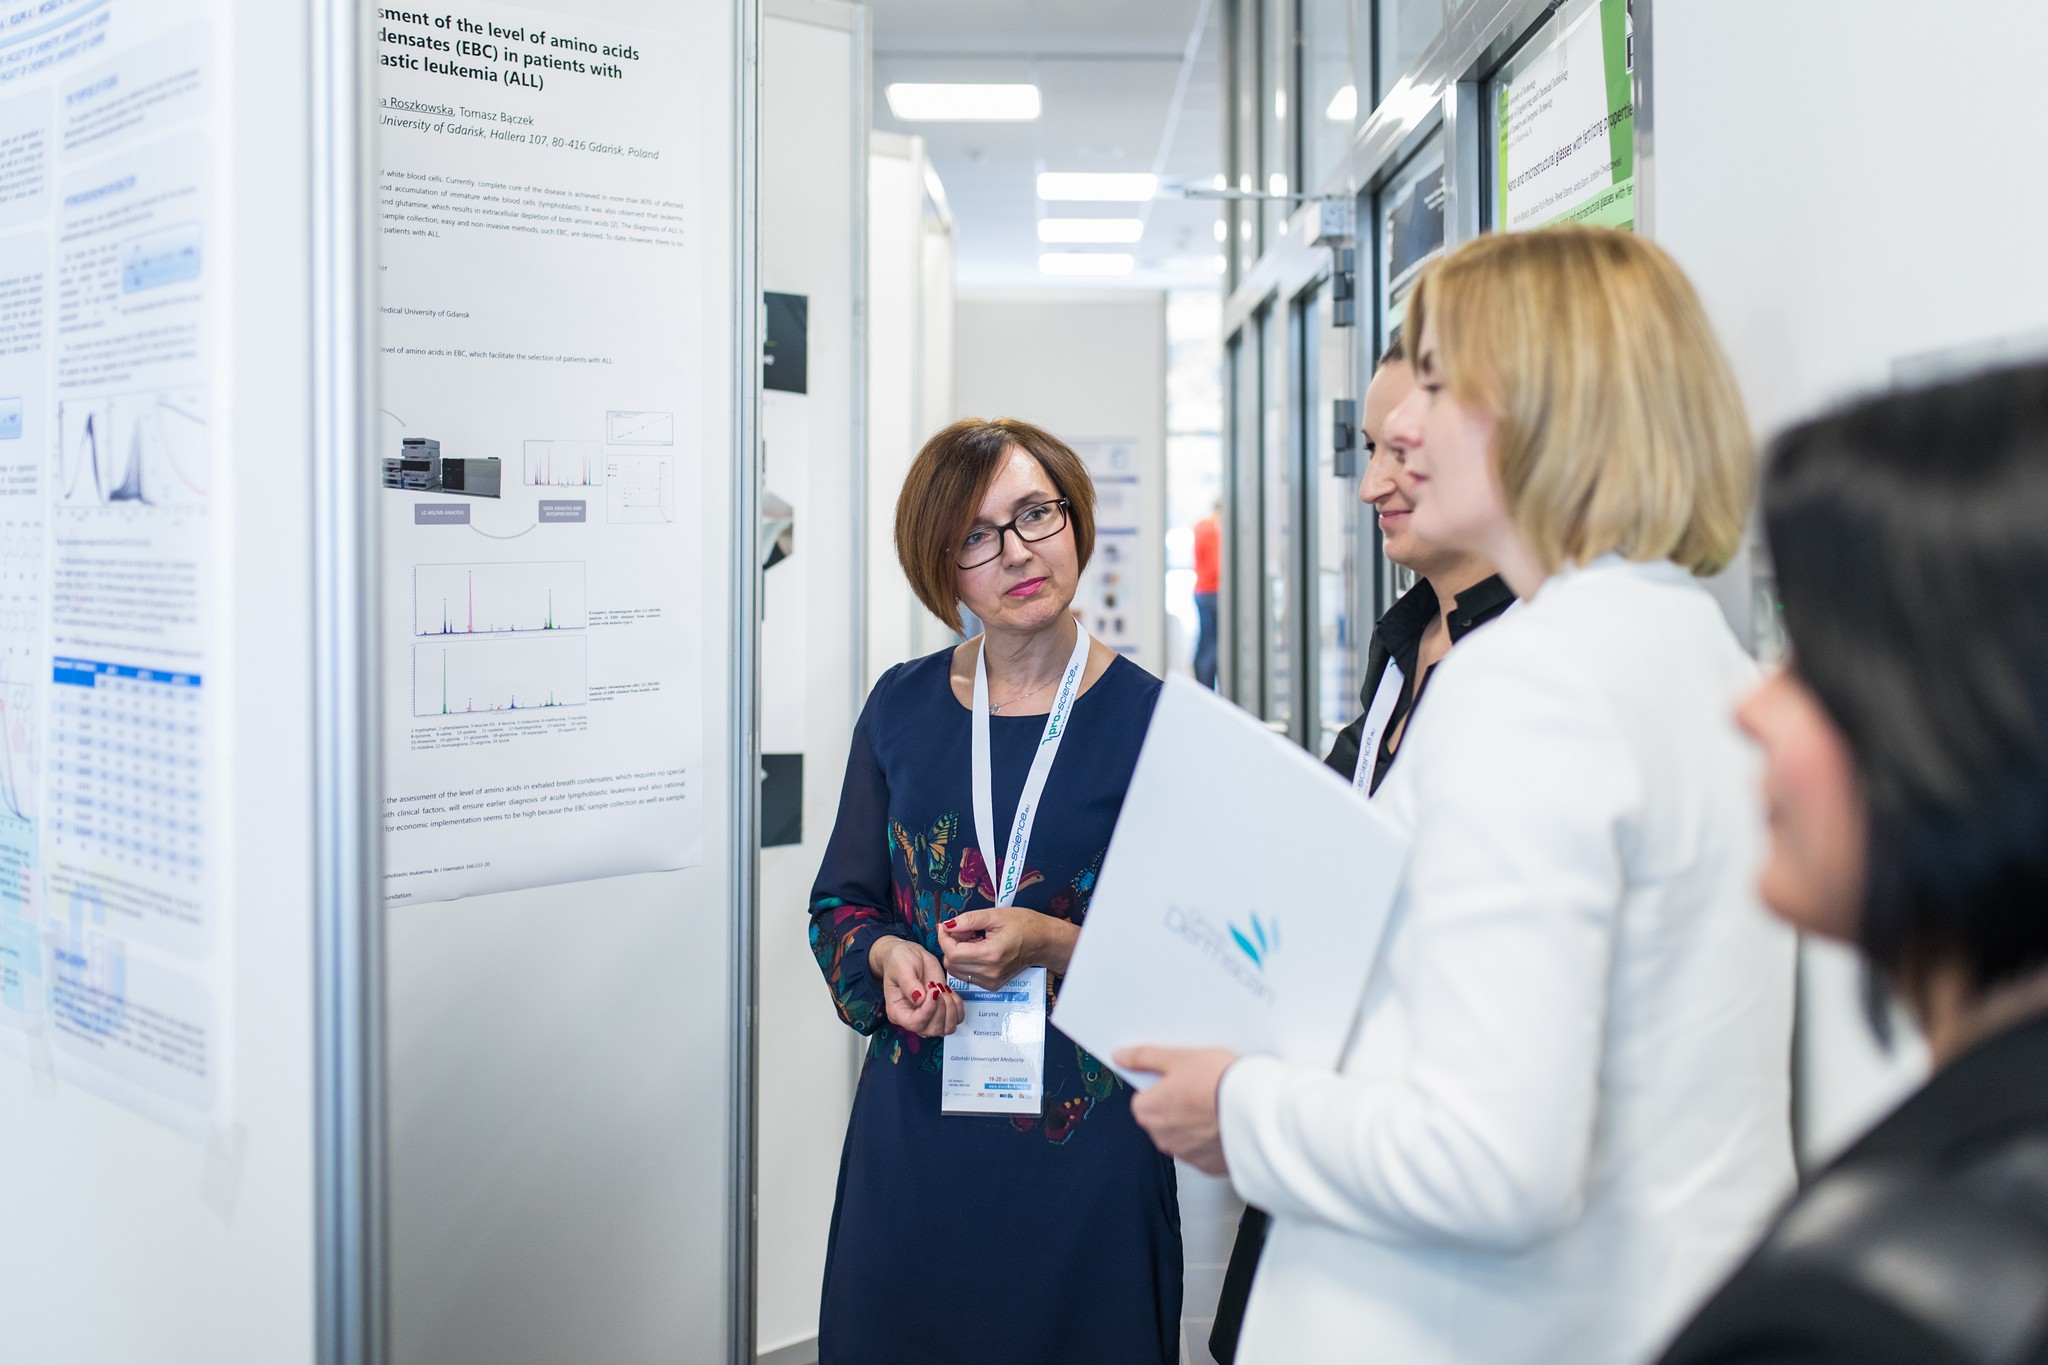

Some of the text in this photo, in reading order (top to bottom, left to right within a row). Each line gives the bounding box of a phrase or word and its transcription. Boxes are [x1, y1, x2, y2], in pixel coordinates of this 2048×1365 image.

[434, 15, 451, 29] of
[456, 18, 482, 34] the
[488, 22, 524, 41] level
[530, 31, 545, 44] of
[550, 37, 597, 53] amino
[602, 45, 638, 60] acids
[456, 40, 497, 62] (EBC)
[504, 48, 517, 62] in
[524, 54, 584, 72] patients
[590, 64, 621, 78] with
[424, 56, 497, 81] leukemia
[504, 70, 543, 91] (ALL)
[390, 96, 533, 125] Roszkowska, Tomasz Bączek
[380, 115, 659, 159] University of Gdańsk, Hallera 107, 80-416 Gdańsk, Poland
[1555, 143, 1572, 166] glasses
[406, 172, 426, 180] blood
[544, 188, 565, 196] disease
[1600, 194, 1614, 210] glasses
[404, 308, 436, 317] University
[399, 793, 436, 802] assessment
[531, 781, 554, 789] exhaled
[397, 808, 419, 816] clinical
[508, 797, 538, 806] diagnosis
[396, 822, 428, 831] economic
[430, 817, 481, 827] implementation
[522, 810, 536, 818] high
